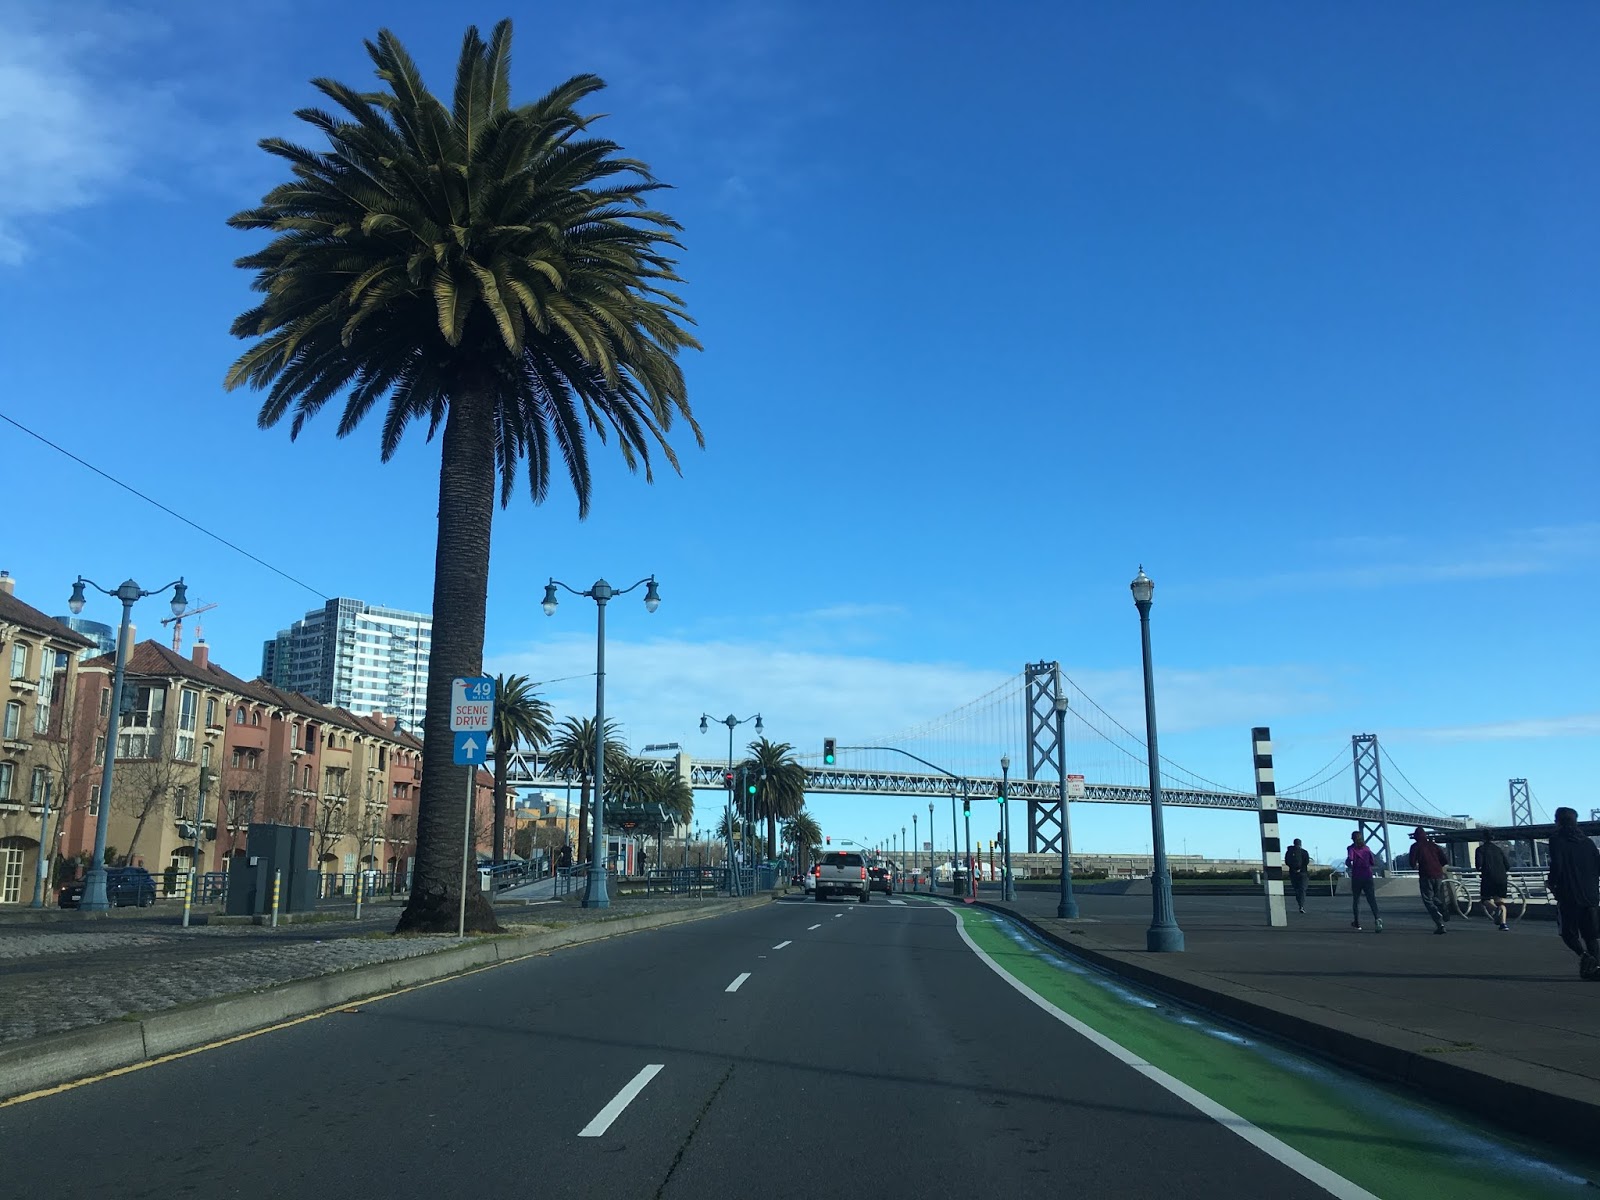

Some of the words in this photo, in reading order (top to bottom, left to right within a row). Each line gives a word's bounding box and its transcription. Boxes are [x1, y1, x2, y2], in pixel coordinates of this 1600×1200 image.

[472, 682, 491, 696] 49
[456, 706, 488, 715] SCENIC
[456, 716, 488, 725] DRIVE
